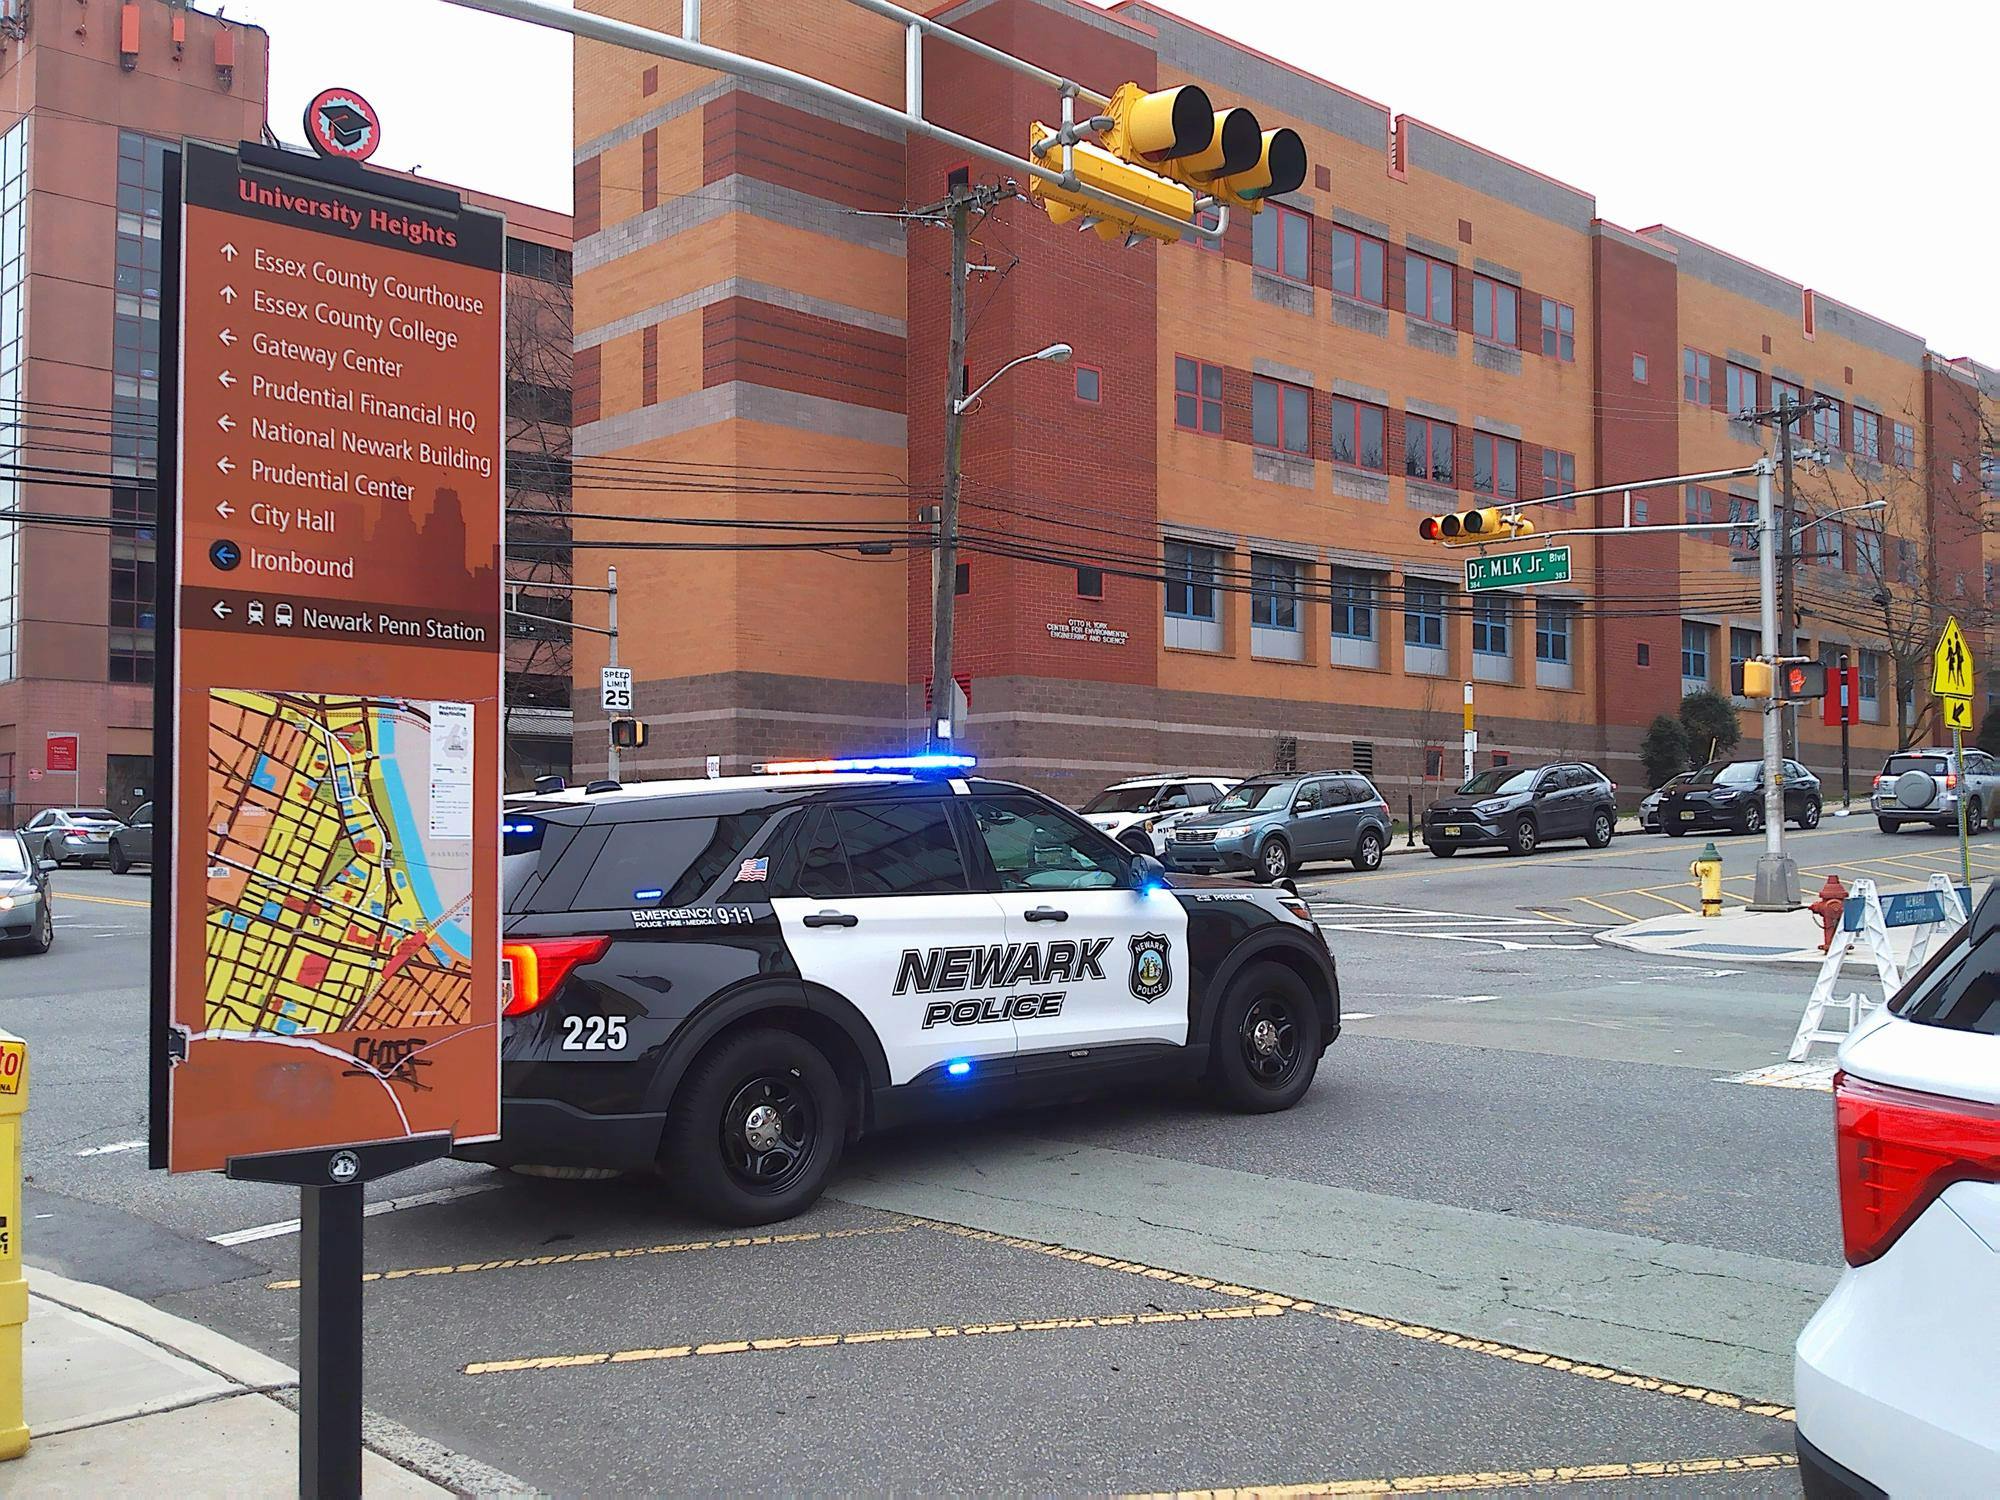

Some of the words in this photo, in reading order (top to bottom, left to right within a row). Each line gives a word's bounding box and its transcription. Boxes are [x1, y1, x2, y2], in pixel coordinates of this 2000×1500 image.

[239, 178, 362, 230] University
[369, 208, 458, 248] Heights
[254, 248, 307, 279] Essex
[312, 261, 378, 298] County
[383, 276, 484, 315] Courthouse
[254, 290, 309, 320] Essex
[314, 303, 383, 339] County
[389, 317, 458, 351] College
[252, 333, 338, 372] Gateway
[342, 349, 403, 378] Center
[252, 375, 353, 412] Prudential
[360, 393, 442, 426] Financial
[448, 408, 476, 434] HQ
[251, 417, 335, 450] National
[342, 431, 413, 461] Newark
[419, 443, 492, 478] Building
[251, 459, 349, 492] Prudential
[354, 474, 415, 501] Center
[250, 503, 291, 533] City
[296, 508, 336, 533] Hall
[250, 547, 354, 579] Ironbound
[1468, 562, 1487, 580] Dr.
[1490, 557, 1522, 577] MLK
[1526, 555, 1545, 573] Jr.
[1549, 552, 1566, 563] Blvd
[1469, 581, 1480, 589] 384
[1555, 571, 1566, 580] 383
[303, 608, 373, 633] Newark
[379, 615, 421, 637] Penn
[426, 619, 486, 642] Station
[1046, 623, 1070, 632] CENTER
[1084, 627, 1129, 639] ENVIRONMENTAL
[1050, 630, 1088, 641] ENGINEERING
[1089, 635, 1101, 643] AND
[1102, 636, 1126, 645] SCIENCE
[1068, 619, 1085, 627] OTTO
[1093, 621, 1108, 630] YORK
[604, 671, 630, 679] SPEED
[606, 680, 627, 688] LIMIT
[605, 689, 630, 706] 25
[1212, 893, 1255, 901] PRECINCT
[631, 907, 713, 921] EMERGENCY
[716, 906, 754, 925] 9-1-1
[635, 920, 663, 929] POLICE
[666, 919, 683, 927] FIRE
[686, 918, 717, 926] MEDICAL
[1134, 940, 1165, 954] NEWARK
[892, 936, 1114, 996] NEWARK
[1136, 983, 1164, 995] POLICE
[922, 991, 1066, 1029] POLICE
[562, 1015, 628, 1050] 225
